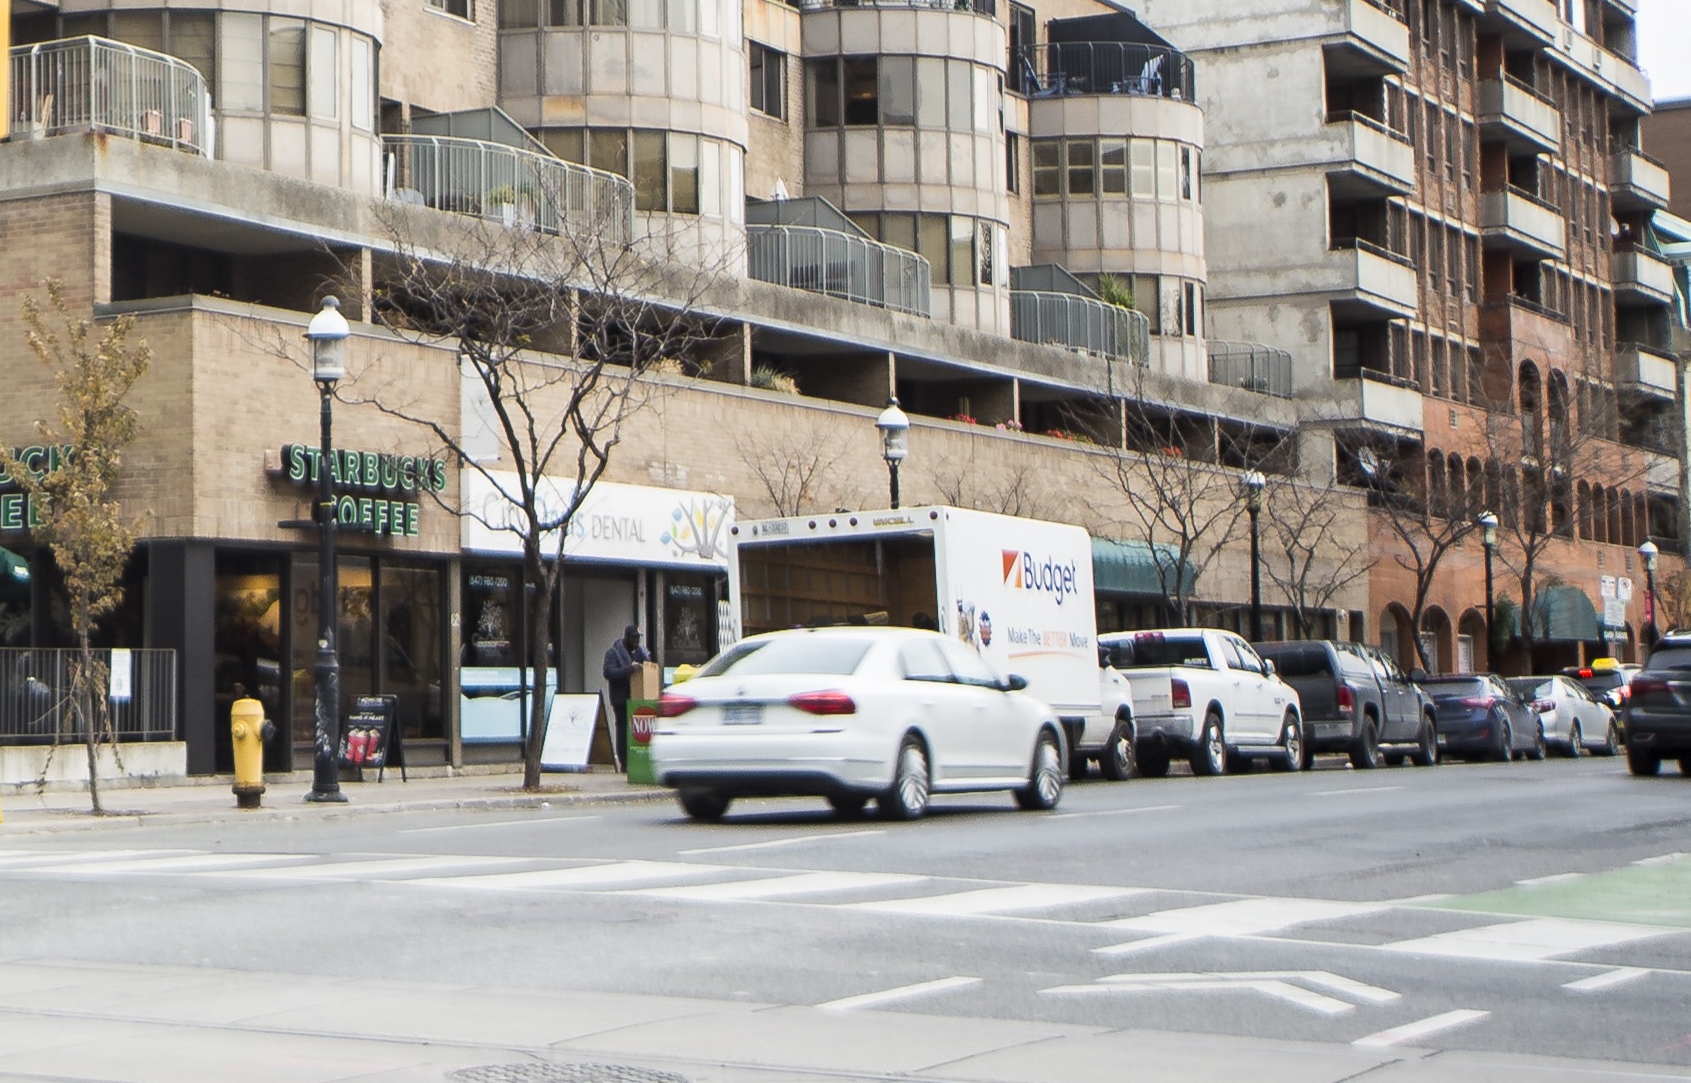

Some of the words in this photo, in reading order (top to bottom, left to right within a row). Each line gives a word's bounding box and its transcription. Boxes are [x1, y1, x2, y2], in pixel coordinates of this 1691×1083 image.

[289, 443, 448, 493] STARBUCKS
[329, 494, 420, 537] OFFEE
[591, 514, 646, 543] DENTAL
[1023, 550, 1078, 606] Budget
[1007, 626, 1028, 646] Make
[1028, 628, 1042, 646] The
[1069, 632, 1089, 649] Move
[632, 717, 657, 734] NOW
